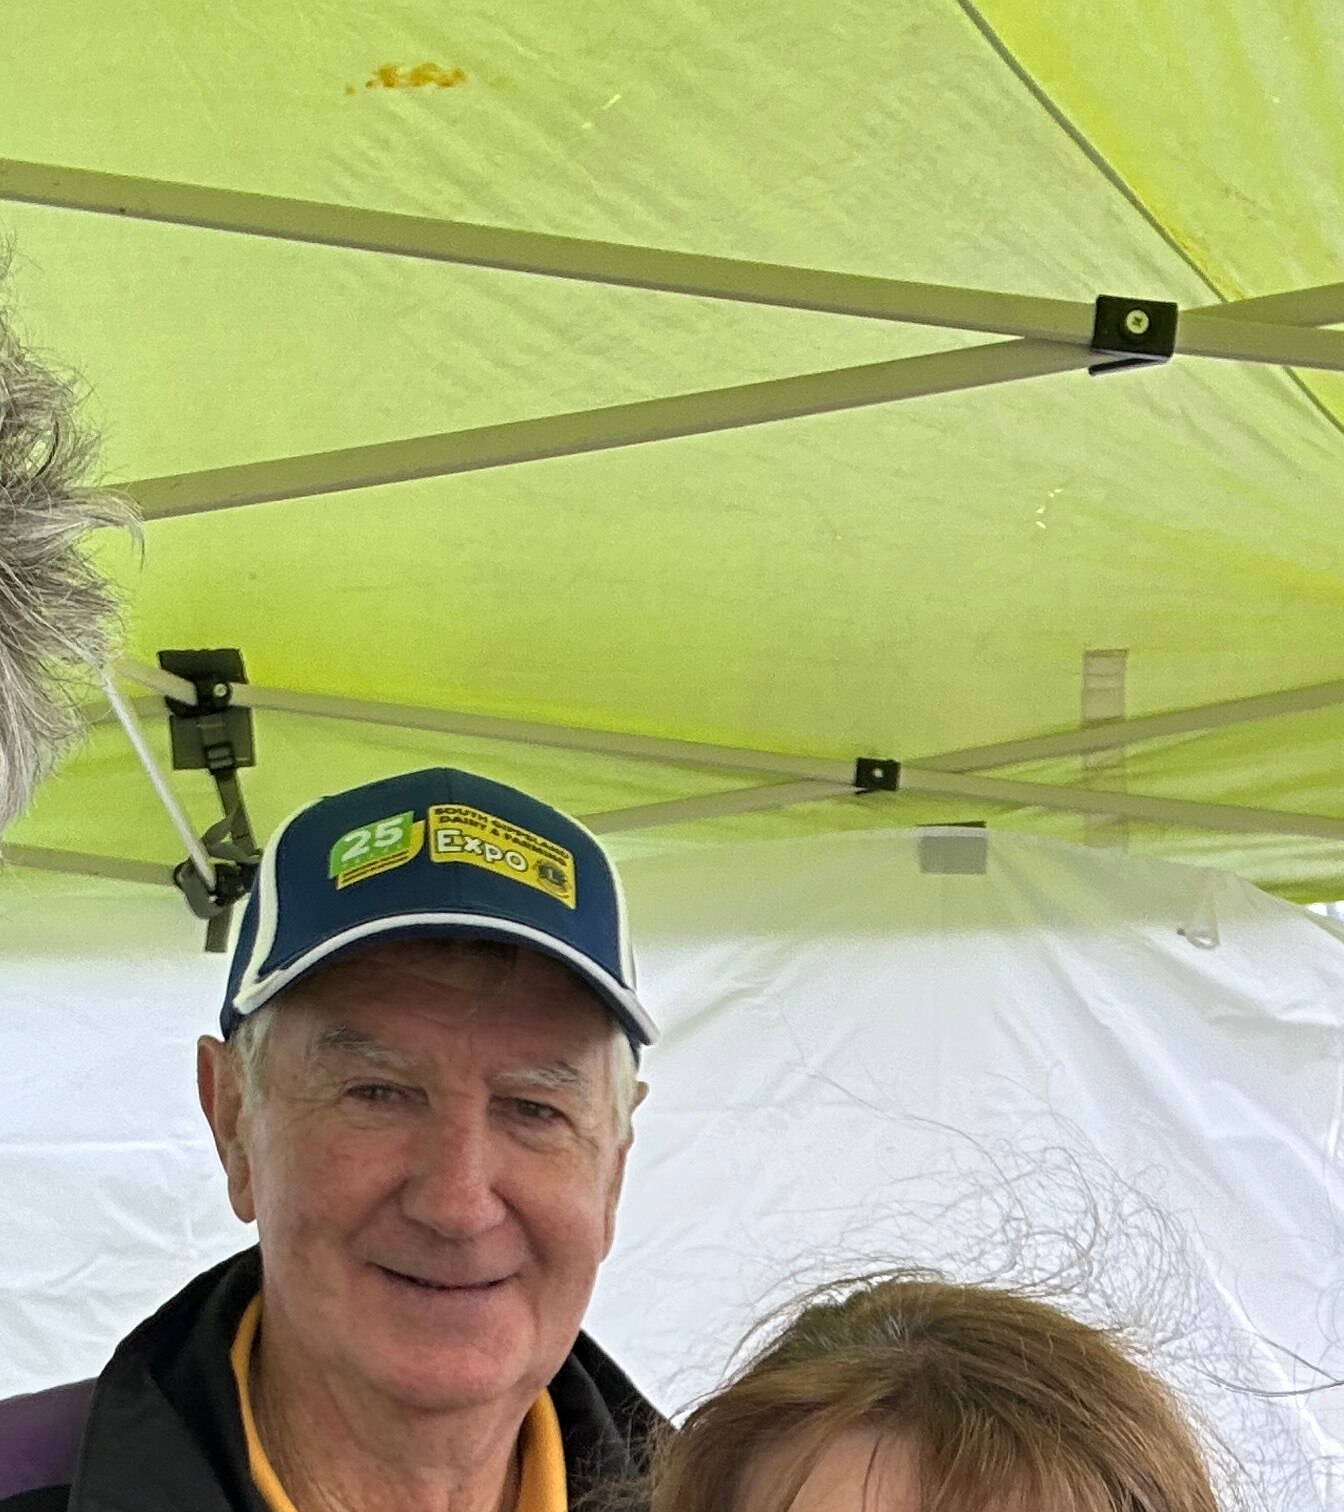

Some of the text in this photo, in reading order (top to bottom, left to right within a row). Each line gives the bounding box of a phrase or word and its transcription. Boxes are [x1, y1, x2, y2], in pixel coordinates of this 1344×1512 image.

[435, 807, 488, 822] SOUTH
[341, 816, 404, 863] 25
[436, 829, 528, 872] Expo
